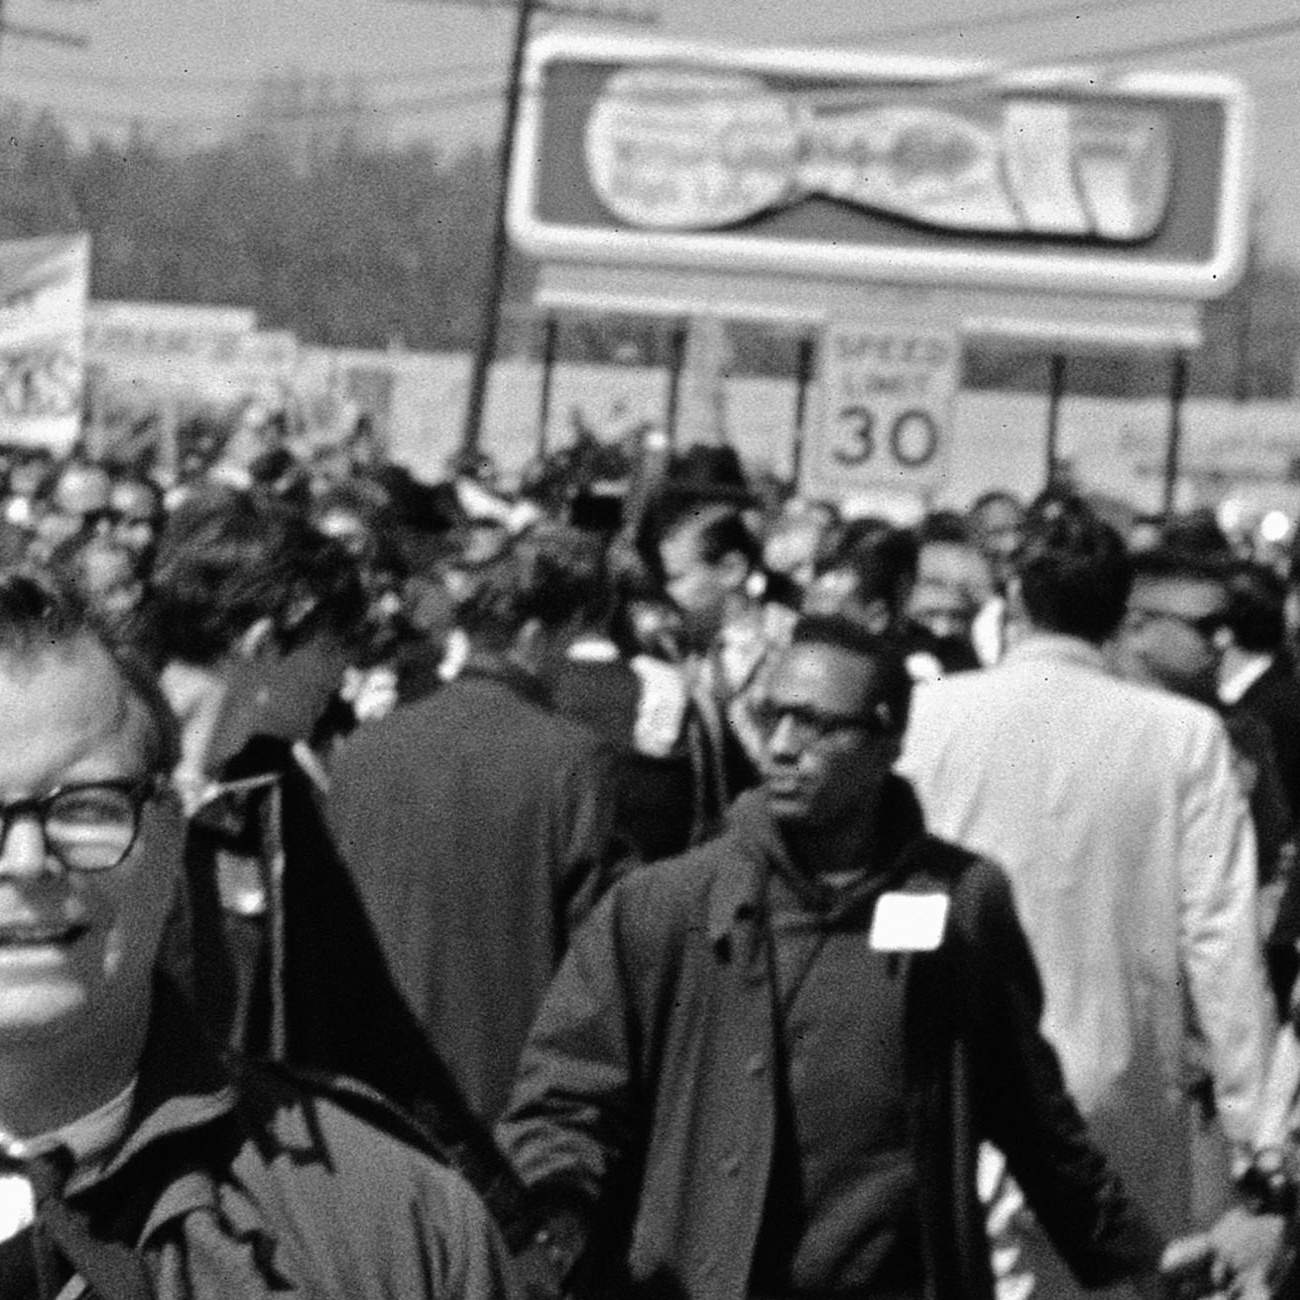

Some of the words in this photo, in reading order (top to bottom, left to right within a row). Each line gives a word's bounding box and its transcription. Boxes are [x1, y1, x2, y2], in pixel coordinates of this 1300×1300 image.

[834, 334, 950, 366] SPEED
[841, 371, 931, 397] LIMIT
[831, 404, 940, 471] 30
